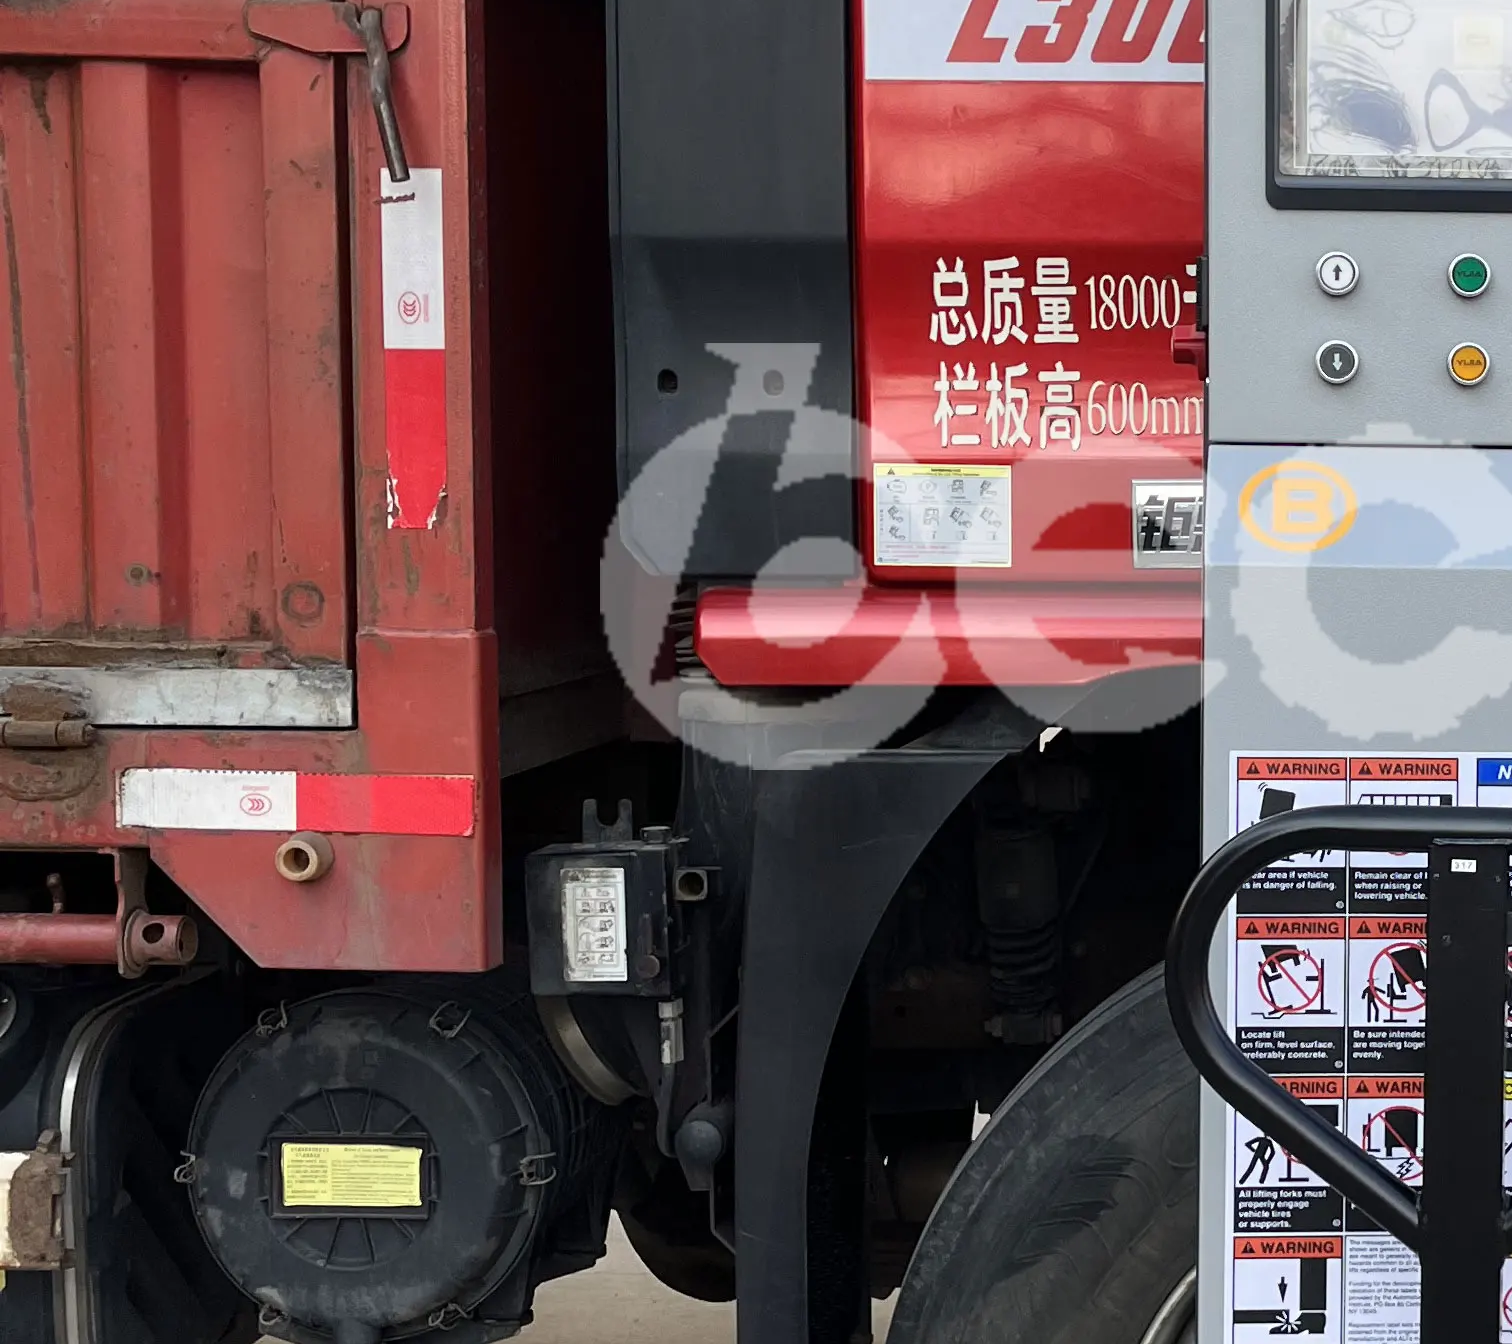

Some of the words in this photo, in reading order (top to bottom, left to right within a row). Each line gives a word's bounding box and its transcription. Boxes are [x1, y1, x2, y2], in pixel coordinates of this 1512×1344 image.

[1267, 763, 1340, 775] WARNING
[1379, 764, 1452, 775] WARNING
[1354, 872, 1387, 880] Remain
[1389, 872, 1411, 880] clear
[1413, 872, 1422, 880] of
[1252, 881, 1261, 889] in
[1262, 881, 1294, 891] danger
[1296, 881, 1306, 889] of
[1307, 881, 1337, 891] falling.
[1354, 882, 1379, 890] when
[1380, 882, 1411, 892] raising
[1412, 882, 1422, 890] or
[1354, 892, 1392, 902] lowering
[1394, 892, 1428, 900] vehicle.
[1266, 922, 1339, 934] WARNING
[1377, 922, 1427, 934] WARN
[1241, 1031, 1271, 1039] Locate
[1273, 1031, 1285, 1039] lift
[1353, 1031, 1366, 1039] Be
[1368, 1031, 1387, 1039] sure
[1241, 1041, 1253, 1049] on
[1255, 1041, 1275, 1049] firm,
[1277, 1041, 1298, 1049] level
[1300, 1041, 1336, 1050] surface,
[1353, 1041, 1366, 1049] are
[1369, 1041, 1402, 1051] moving
[1287, 1051, 1329, 1059] concrete.
[1353, 1052, 1384, 1061] evenly.
[1376, 1082, 1424, 1094] WARN
[1238, 1190, 1251, 1198] All
[1253, 1190, 1278, 1200] lifting
[1279, 1190, 1302, 1198] forks
[1304, 1190, 1327, 1198] must
[1238, 1201, 1274, 1210] properly
[1277, 1201, 1309, 1210] engage
[1238, 1210, 1269, 1218] vehicle
[1271, 1210, 1291, 1218] tires
[1250, 1220, 1291, 1230] supports.
[1261, 1241, 1334, 1253] WARNING
